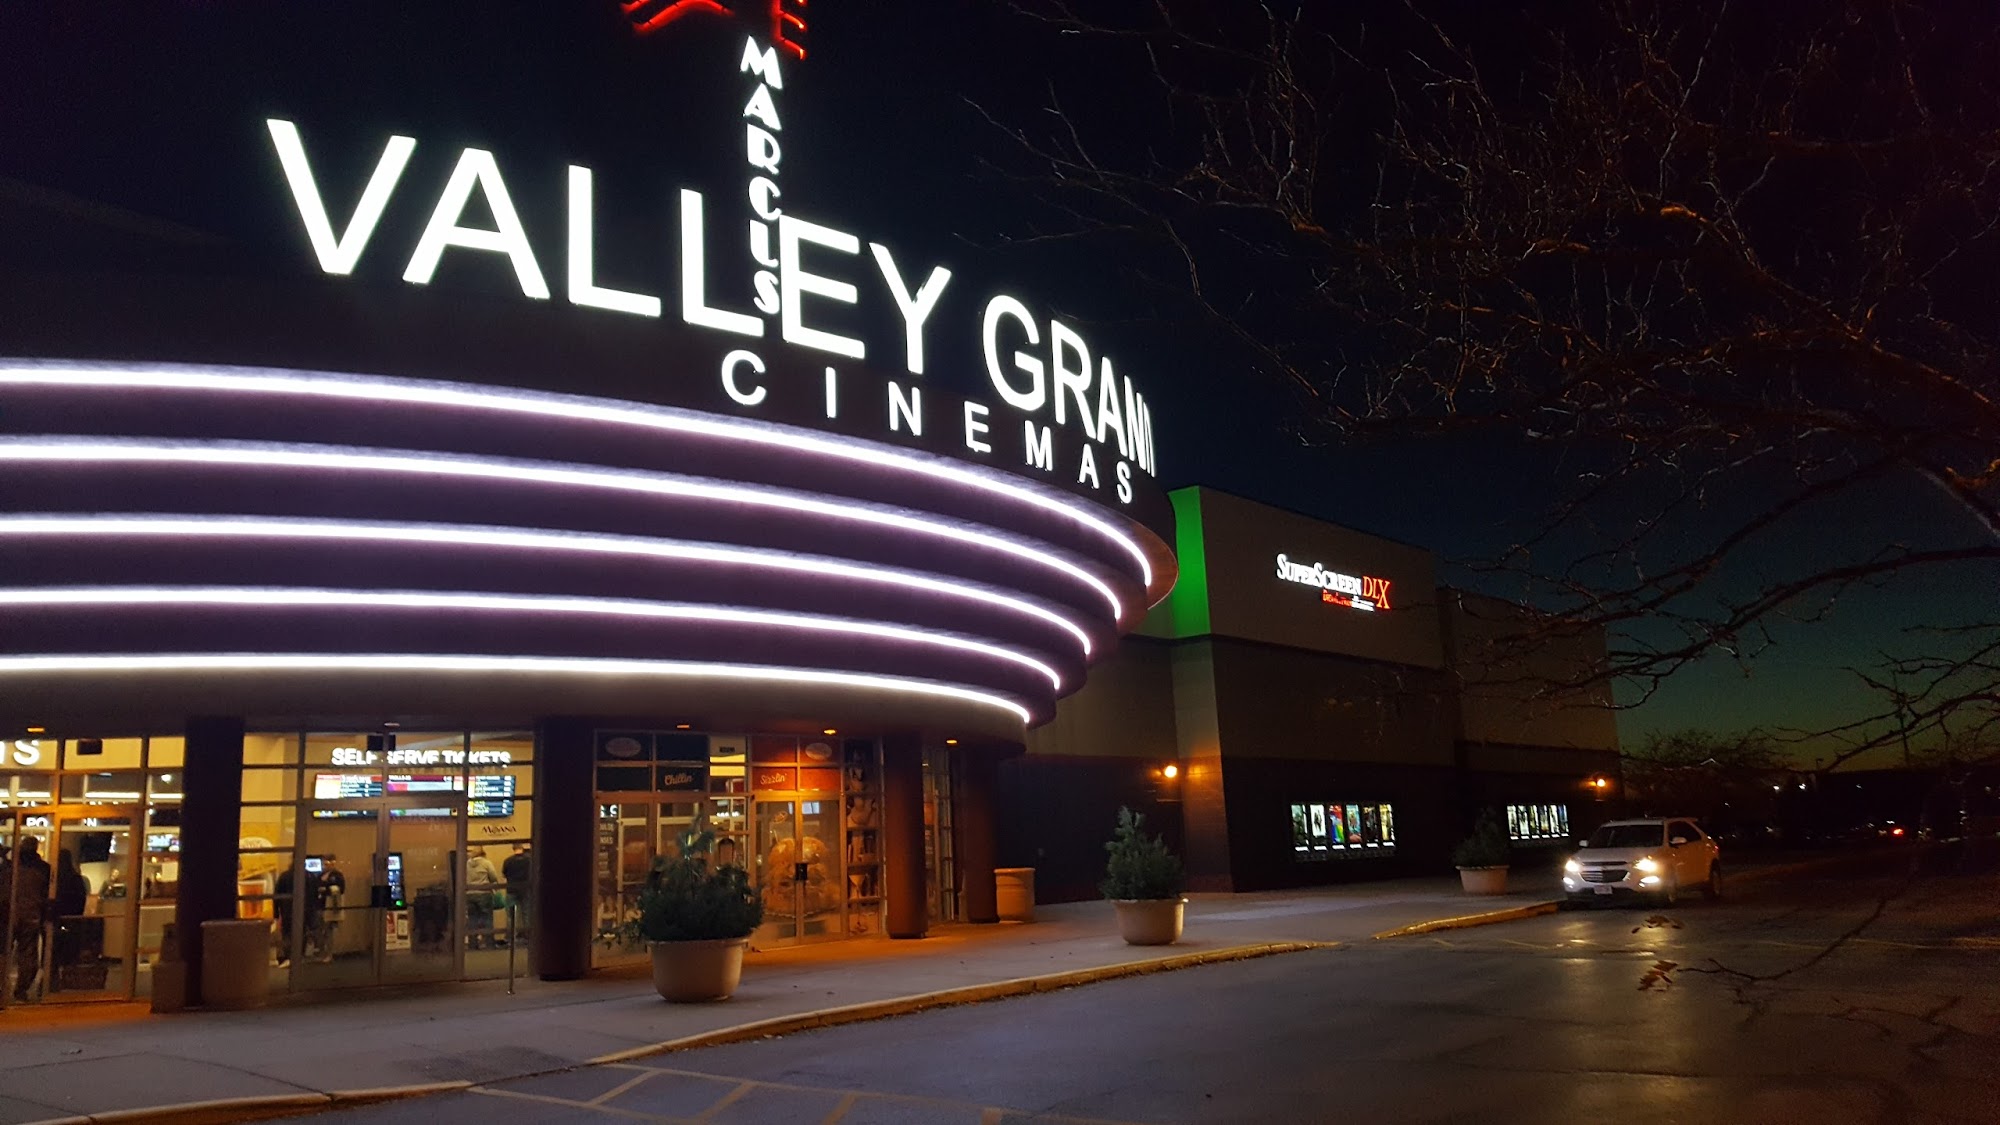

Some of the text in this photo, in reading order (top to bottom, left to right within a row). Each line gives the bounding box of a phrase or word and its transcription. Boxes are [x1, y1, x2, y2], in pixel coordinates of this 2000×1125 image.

[267, 118, 952, 374] VALLEY
[721, 350, 1132, 504] CINEMAS
[1363, 575, 1391, 609] DLX
